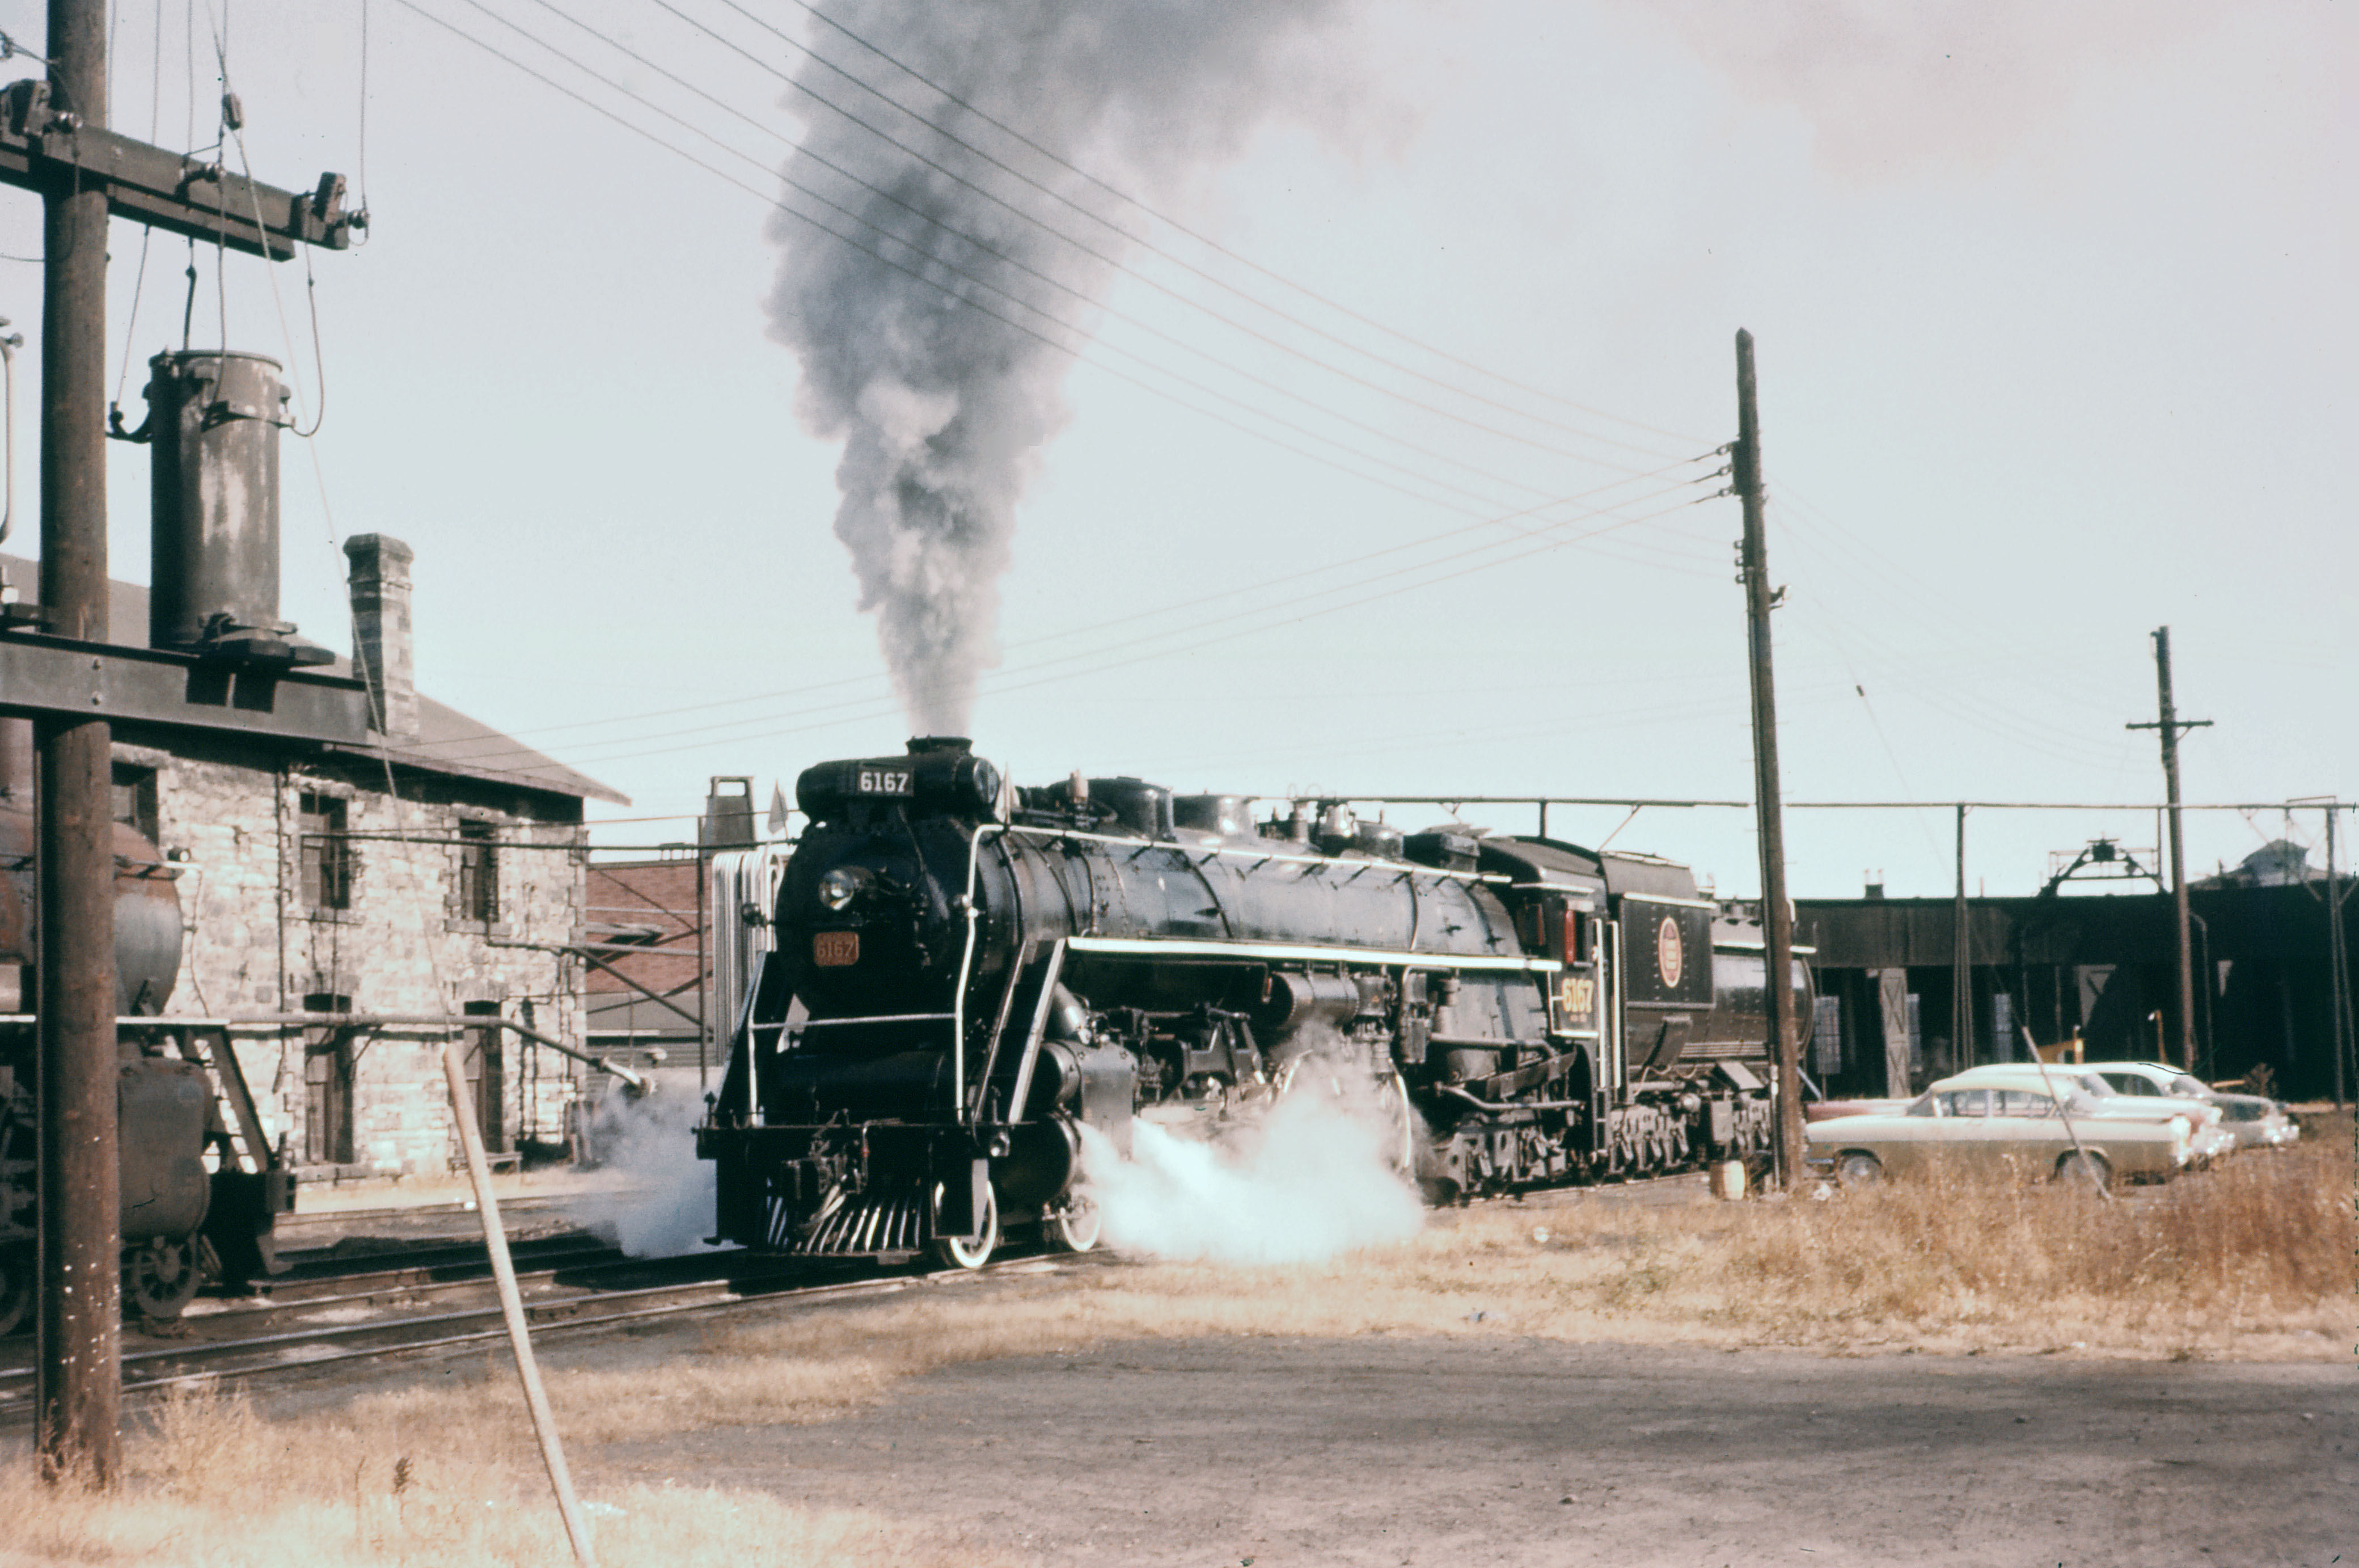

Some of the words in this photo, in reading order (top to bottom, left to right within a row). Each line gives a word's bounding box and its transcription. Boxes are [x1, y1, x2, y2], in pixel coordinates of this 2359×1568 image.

[861, 772, 908, 792] 6167
[817, 940, 854, 958] 6167
[1562, 978, 1593, 1013] 6167
